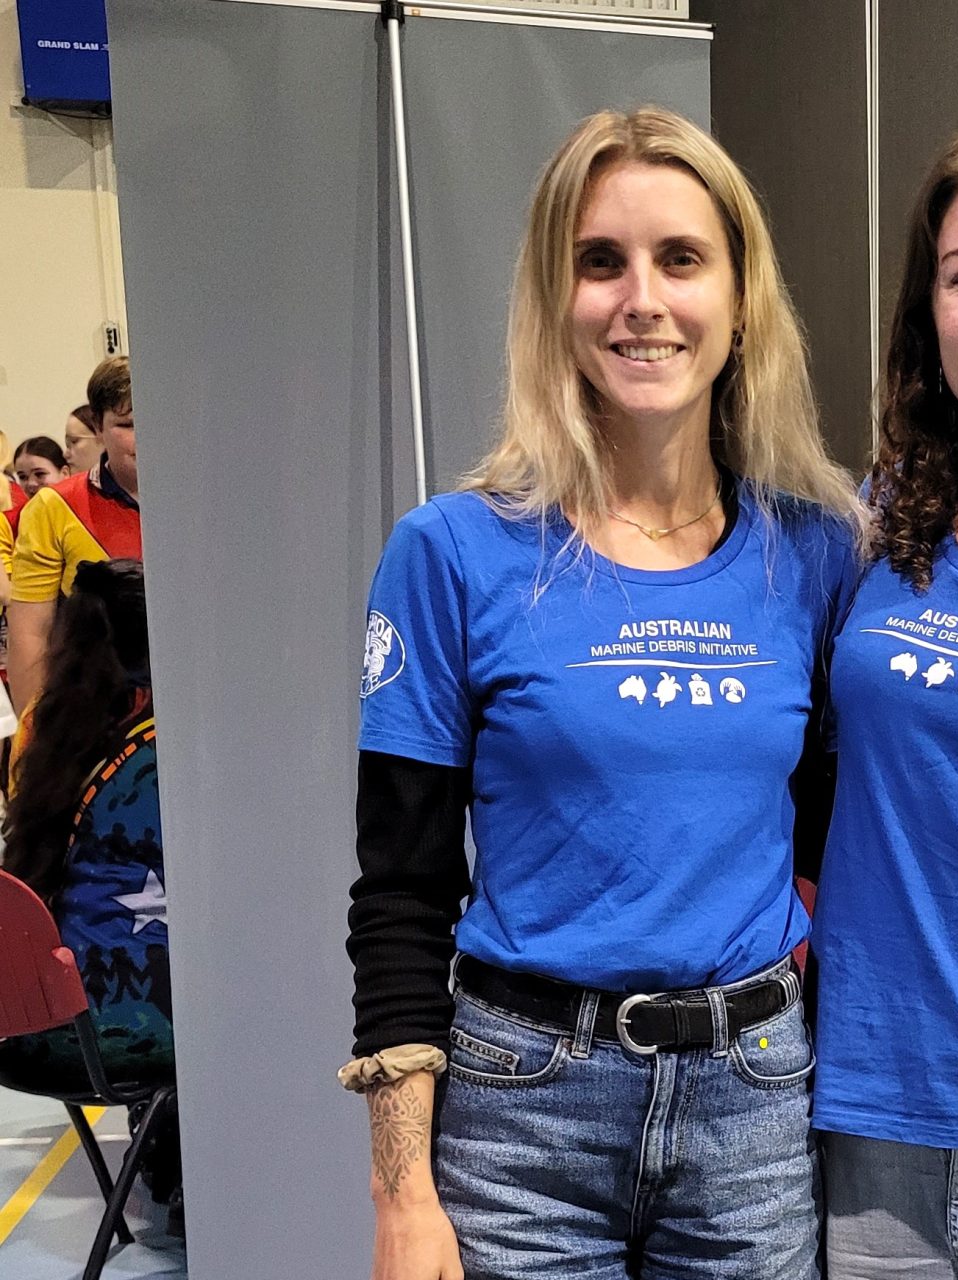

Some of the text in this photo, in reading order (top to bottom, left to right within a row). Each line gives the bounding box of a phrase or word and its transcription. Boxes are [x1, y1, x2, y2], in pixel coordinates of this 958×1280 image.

[37, 40, 71, 49] GRAND
[73, 42, 99, 50] SLAM
[619, 619, 731, 640] AUSTRALIAN
[885, 616, 938, 638] MARINE
[591, 640, 758, 657] MARINE DEBRIS INITIATIVE
